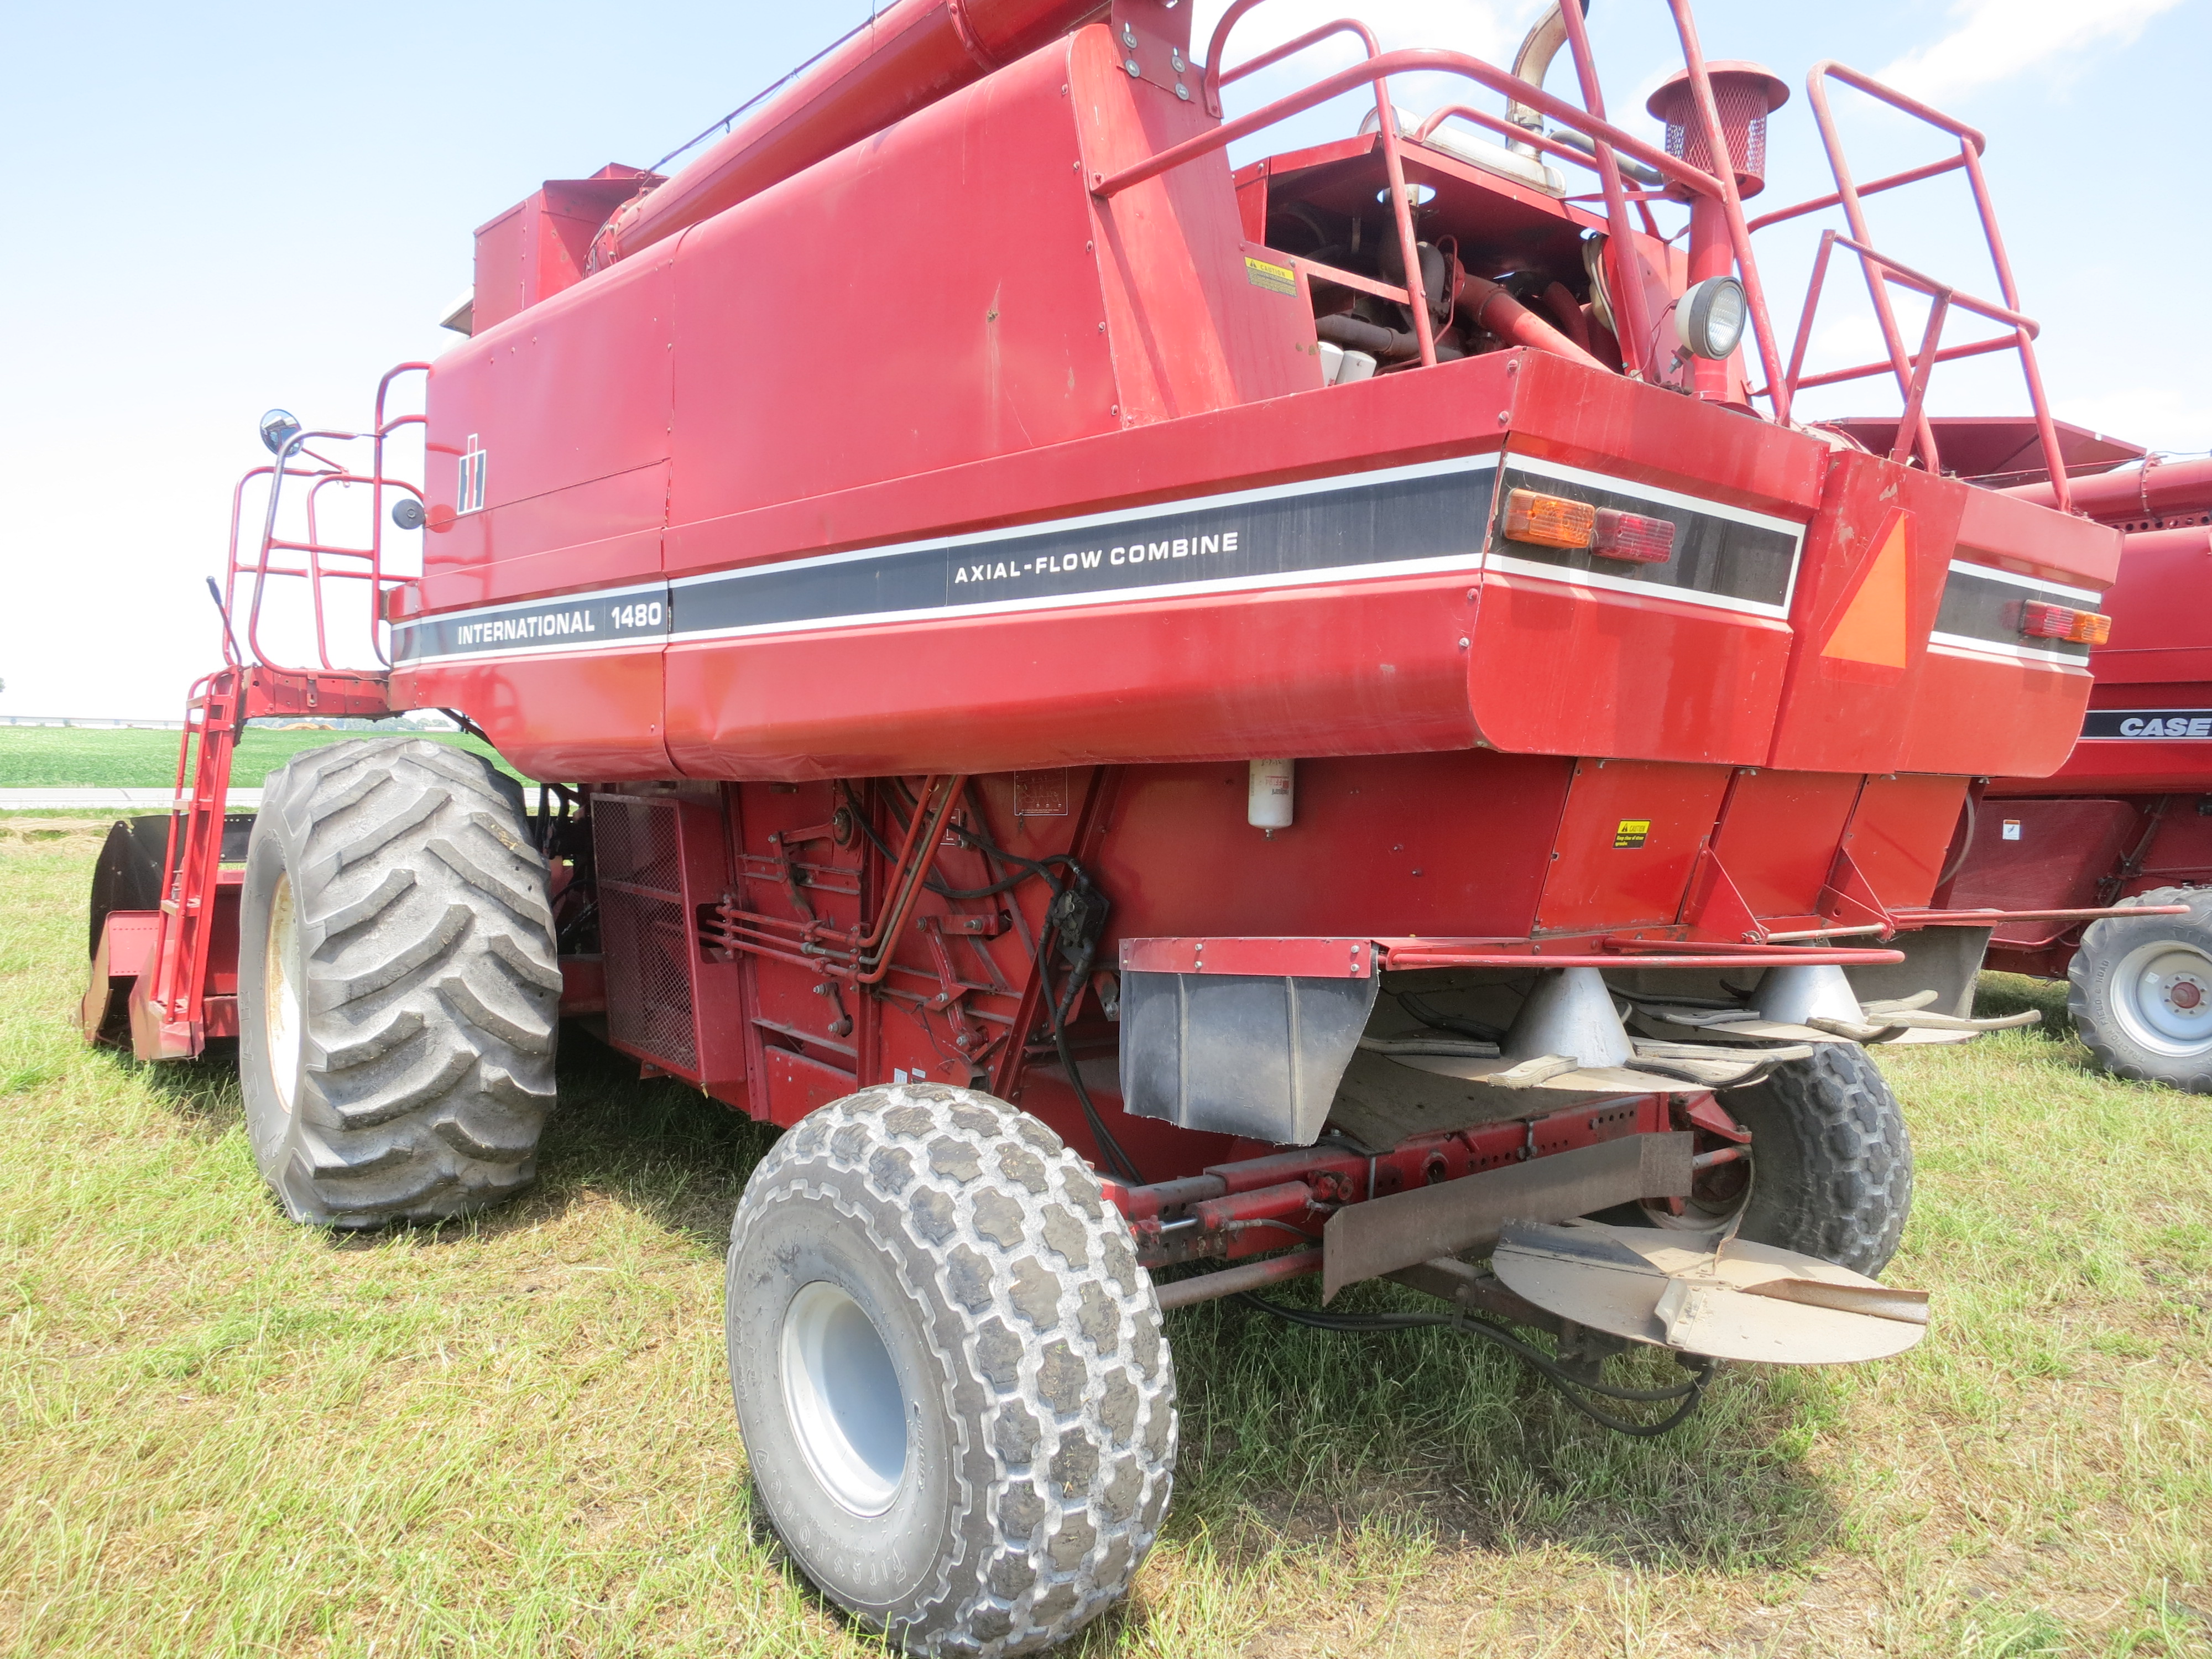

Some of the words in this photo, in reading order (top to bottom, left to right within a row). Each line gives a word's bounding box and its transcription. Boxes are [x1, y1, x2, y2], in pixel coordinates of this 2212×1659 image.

[1260, 264, 1286, 277] CAUTION
[954, 550, 1102, 583] AXIAL-FLOW
[1110, 531, 1239, 565] COMBINE
[457, 610, 595, 645] INTERNATIONAL
[611, 602, 661, 629] 1480
[2120, 718, 2212, 736] CASE
